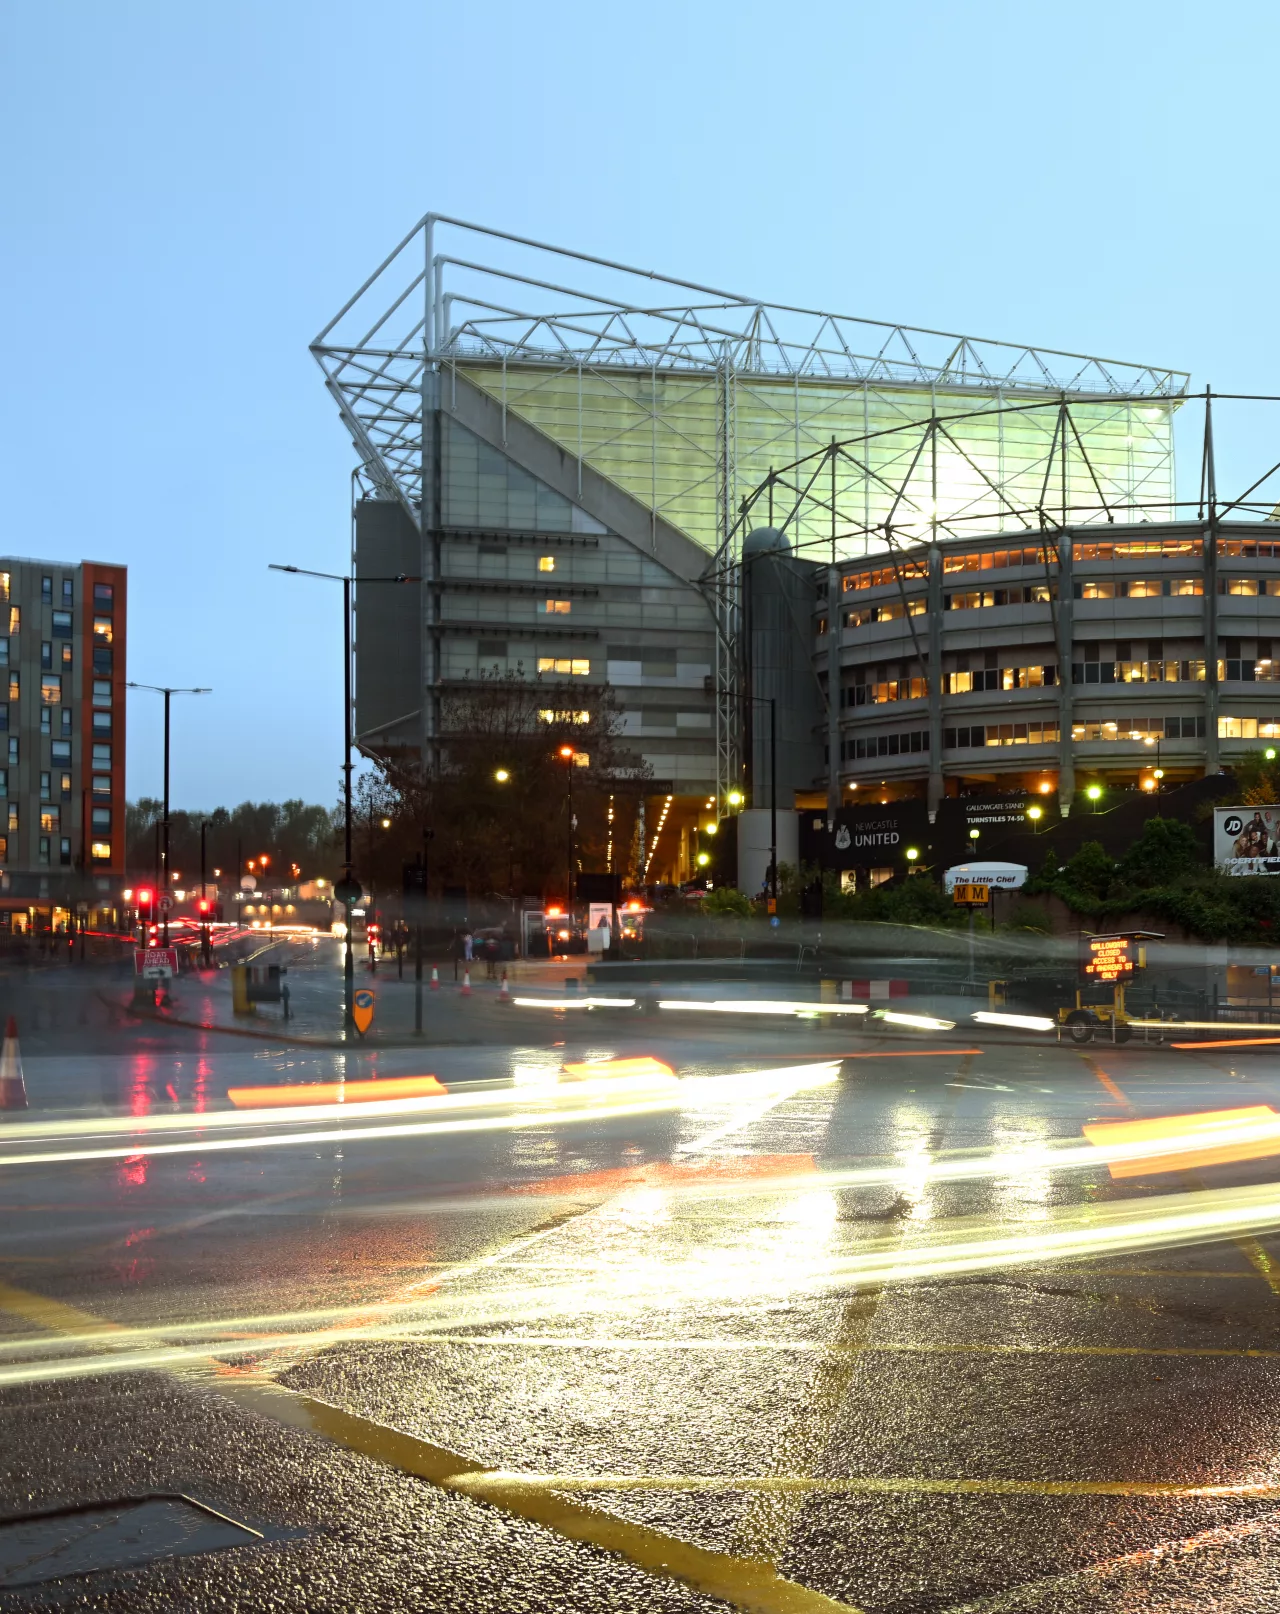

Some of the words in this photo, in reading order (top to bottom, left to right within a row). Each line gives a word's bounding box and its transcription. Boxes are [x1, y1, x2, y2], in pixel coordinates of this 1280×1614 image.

[966, 803, 1004, 811] GALLOWGATE
[855, 820, 899, 831] NEWCASTLE
[1226, 820, 1241, 832] JD
[855, 832, 900, 847] UNITED
[955, 876, 970, 884] The
[996, 875, 1016, 883] Chef
[957, 887, 966, 900] M
[972, 887, 984, 899] M
[1091, 941, 1128, 950] GALLOWGATE
[1098, 949, 1121, 957] CLOSED
[1093, 957, 1116, 965] ACCESS
[1086, 965, 1095, 973] ST
[1096, 964, 1123, 972] ANDREWS
[1125, 962, 1133, 970] ST
[1102, 971, 1118, 979] ONLY
